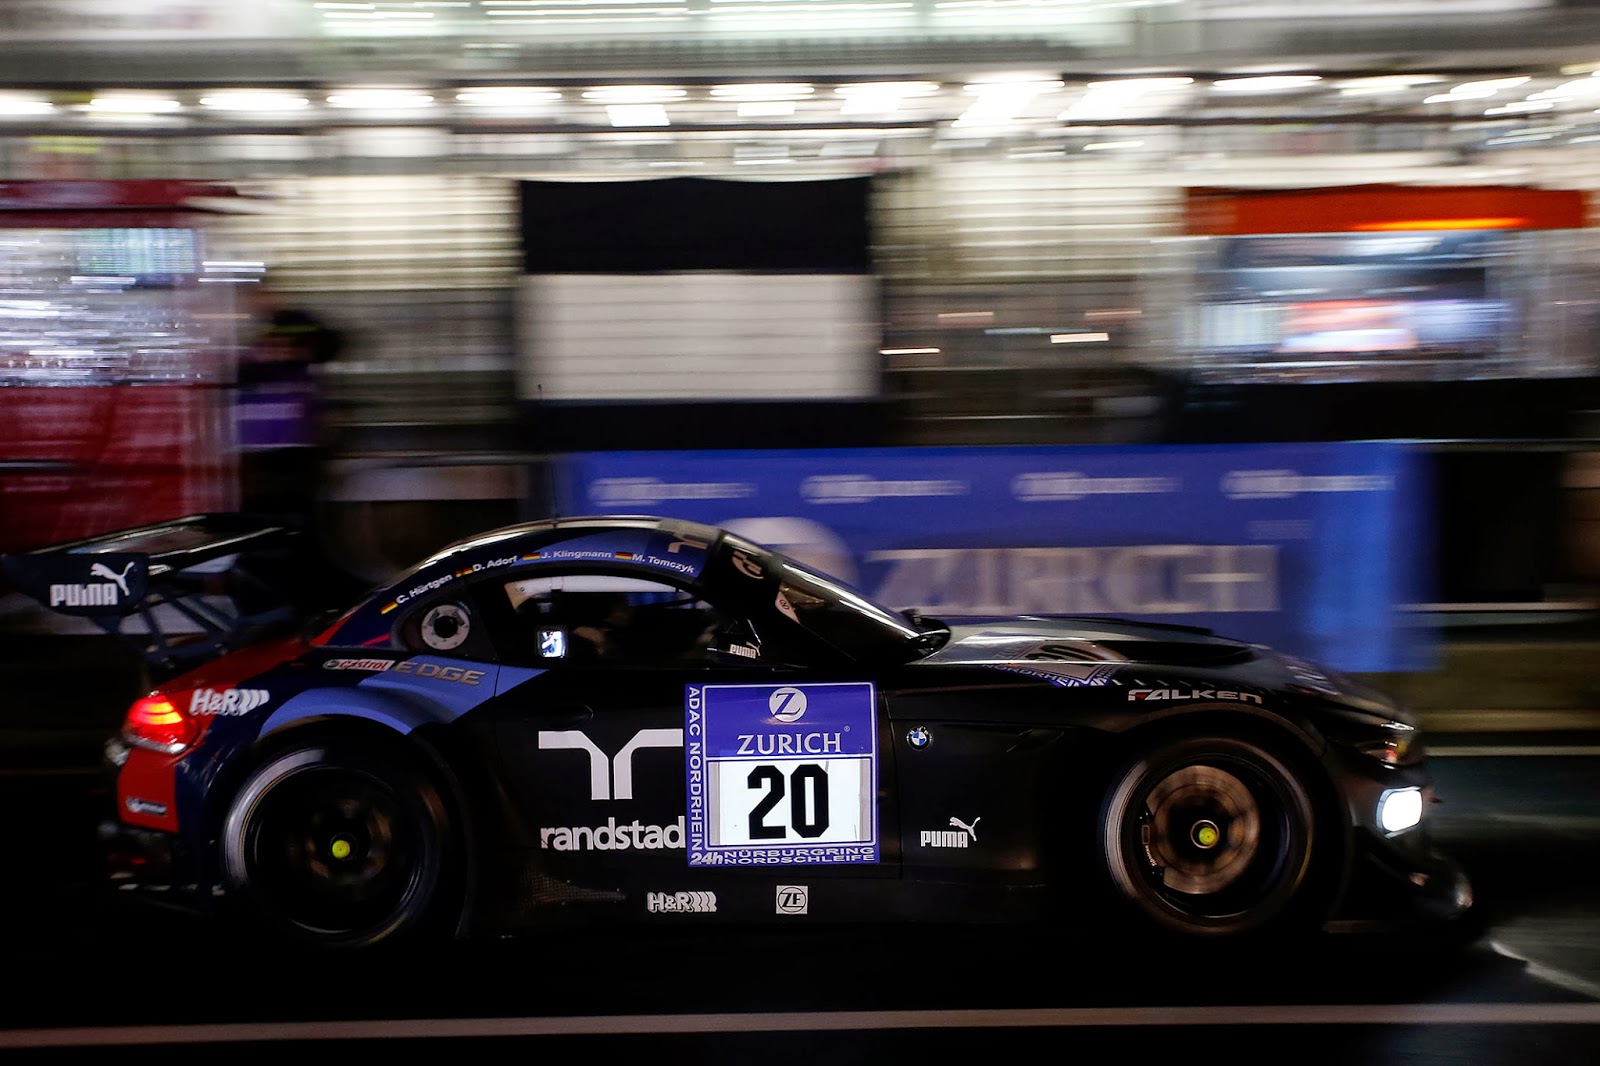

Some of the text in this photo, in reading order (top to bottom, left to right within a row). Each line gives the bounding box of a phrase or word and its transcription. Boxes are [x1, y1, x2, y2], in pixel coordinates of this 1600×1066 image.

[472, 555, 518, 572] D. Adorf
[540, 550, 612, 559] J. Klingmann
[631, 553, 695, 574] M. Tomczyk
[51, 583, 118, 606] PUMA
[396, 573, 453, 604] C. Hürtgen
[729, 644, 756, 659] PUMA
[338, 659, 487, 686] Castrol EDGE
[190, 688, 252, 716] H&R
[1128, 689, 1263, 704] FALKEN
[736, 732, 841, 755] ZURICH
[689, 687, 703, 850] ADAC NORDRHEIN
[747, 764, 829, 840] 20
[540, 815, 686, 850] randstad
[920, 830, 968, 848] PUMA
[690, 852, 723, 865] 24h
[724, 847, 875, 858] NÜRBURGRING
[724, 854, 875, 865] NORDSCHLEIFE
[647, 891, 702, 912] H&R
